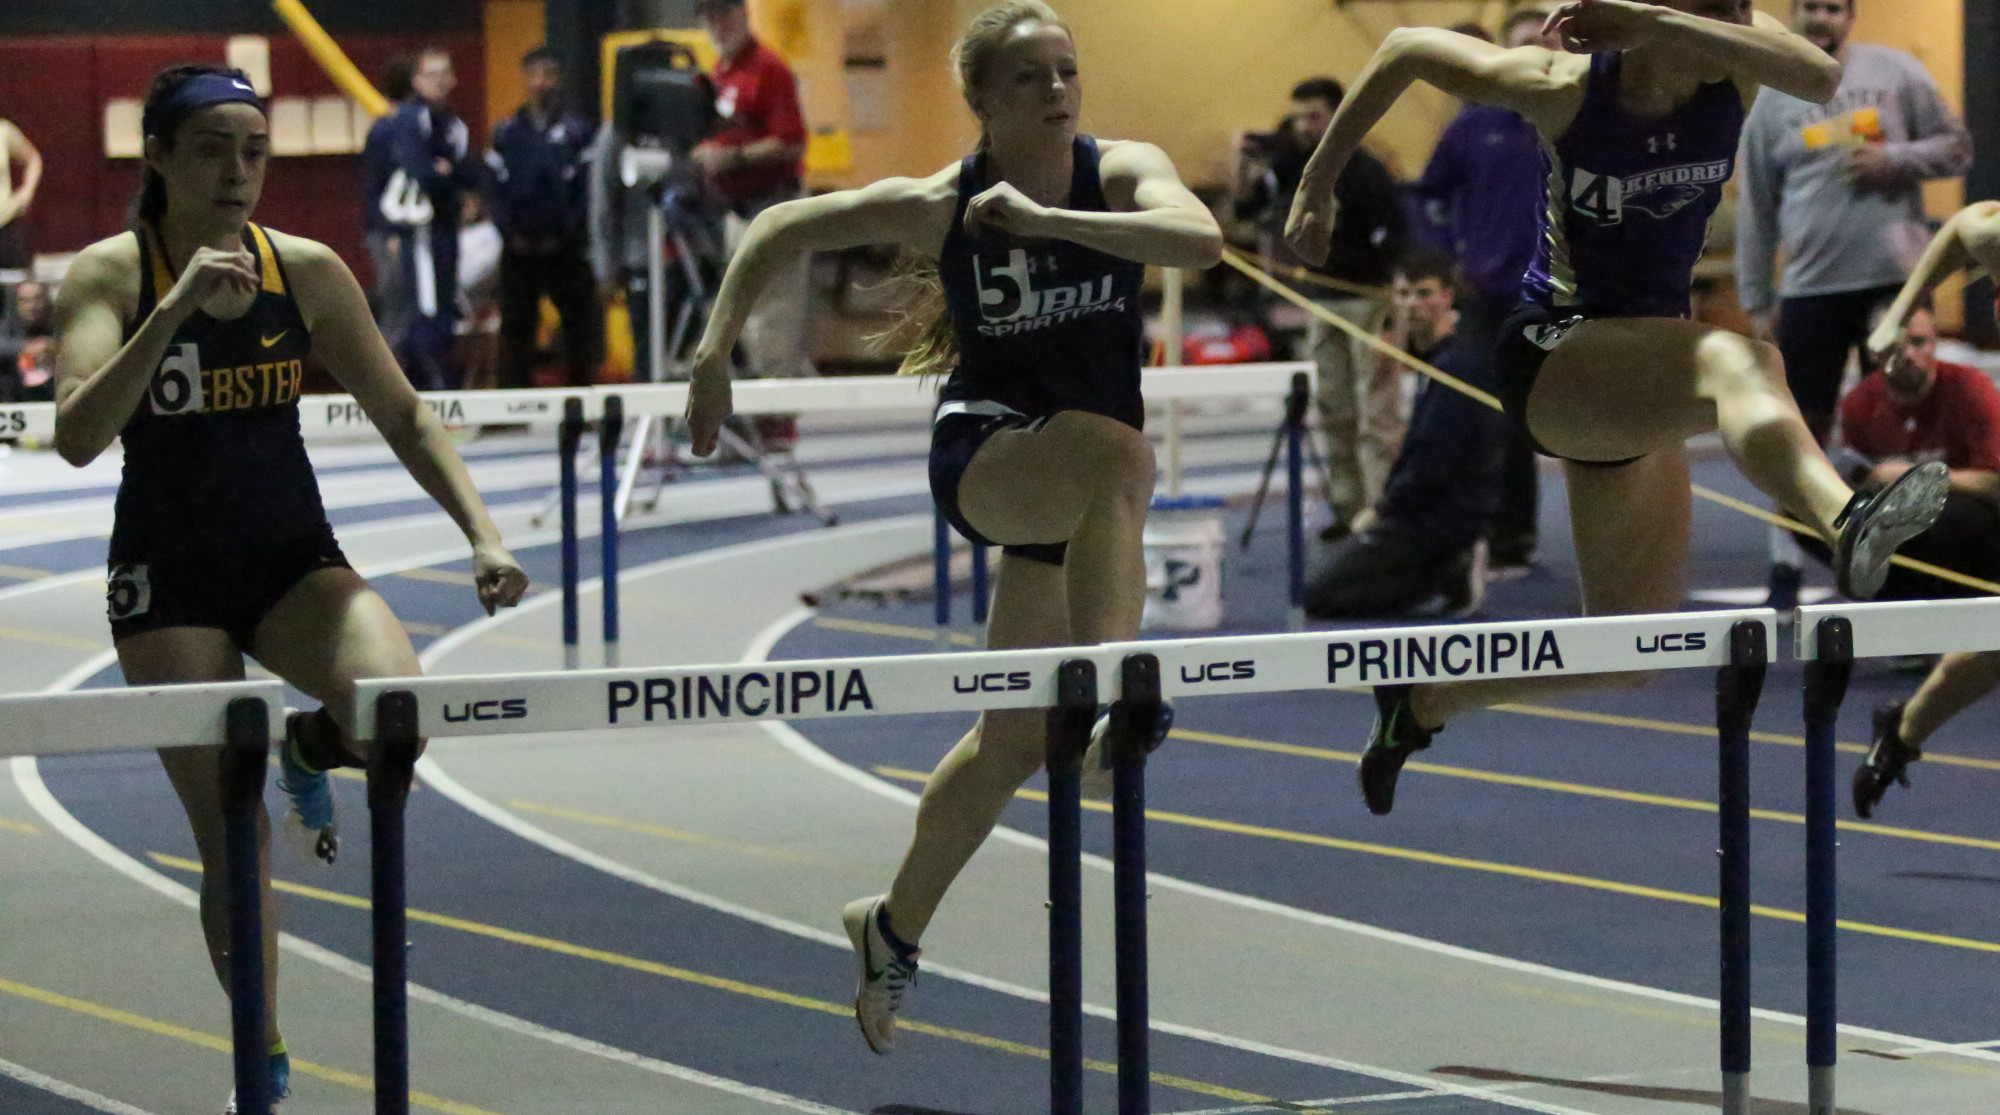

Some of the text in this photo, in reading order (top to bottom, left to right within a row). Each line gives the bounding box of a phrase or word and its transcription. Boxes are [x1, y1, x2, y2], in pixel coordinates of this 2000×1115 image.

[1574, 174, 1616, 221] 4
[1621, 163, 1728, 193] KENDREE
[979, 250, 1021, 317] 5
[152, 345, 191, 412] 6
[197, 359, 302, 413] EBSTER
[1181, 630, 1707, 684] UCS PRINCIPIA UCS
[443, 669, 1031, 724] UCS PRINCIPIA UCS
